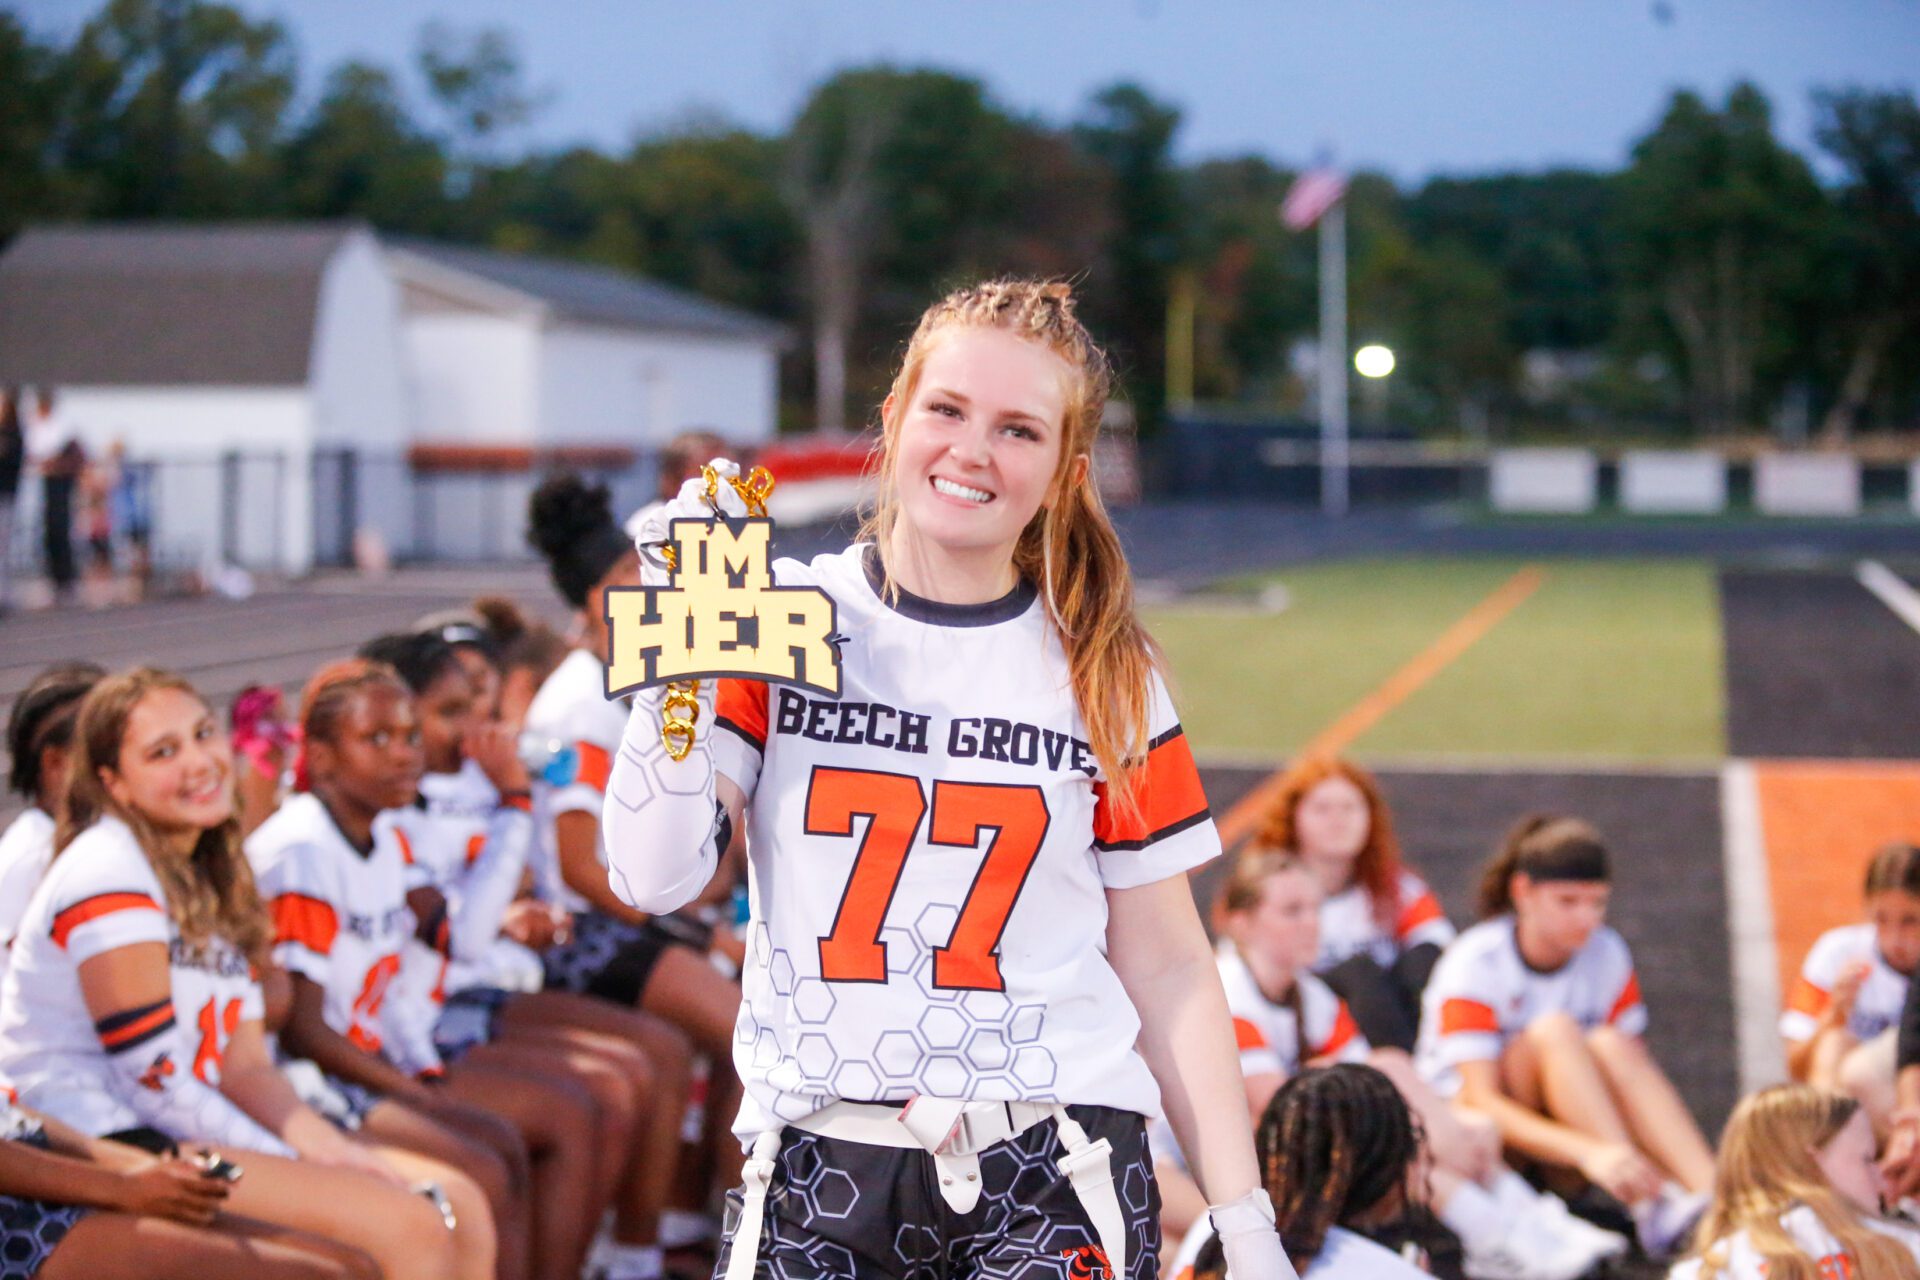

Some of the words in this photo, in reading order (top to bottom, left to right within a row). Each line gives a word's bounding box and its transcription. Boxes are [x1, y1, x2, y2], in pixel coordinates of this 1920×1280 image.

[607, 590, 838, 694] HER
[776, 687, 932, 754] BEECH
[947, 717, 1098, 778] GROVE
[803, 764, 1051, 993] 77
